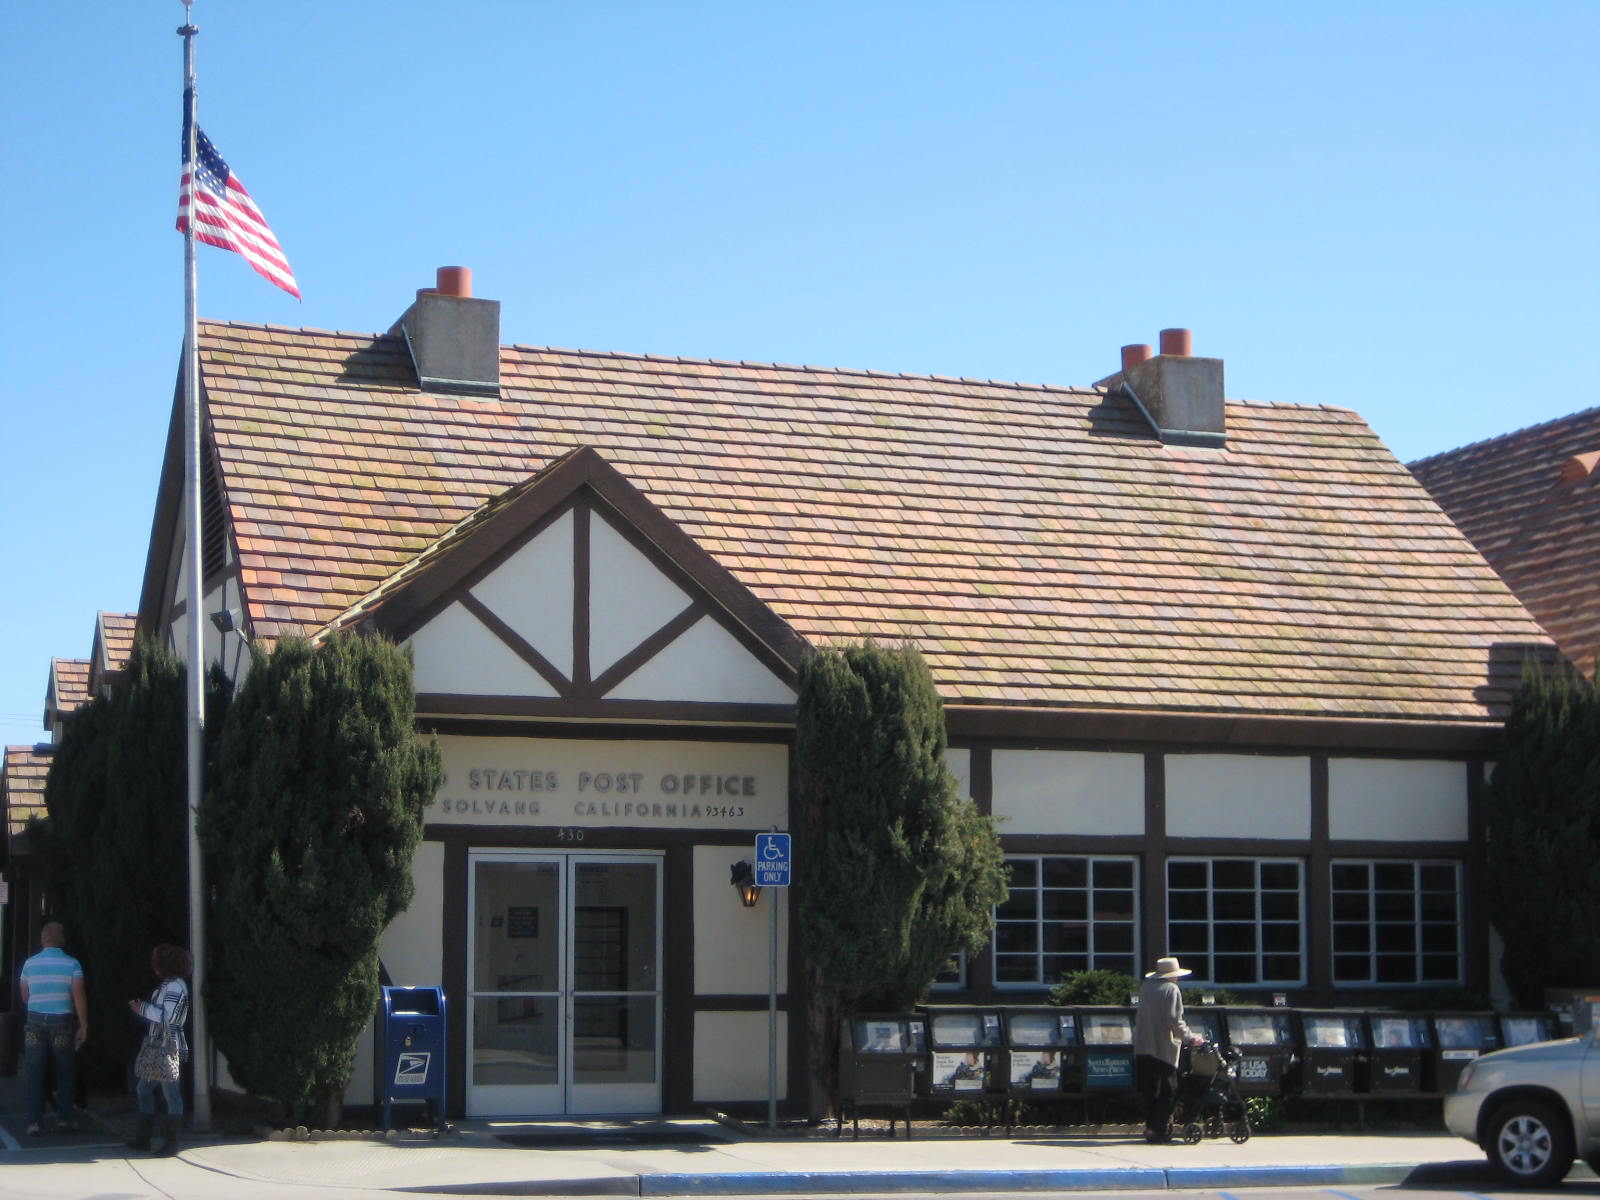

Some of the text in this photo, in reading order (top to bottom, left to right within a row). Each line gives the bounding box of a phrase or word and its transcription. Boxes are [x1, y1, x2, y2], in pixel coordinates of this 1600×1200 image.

[469, 768, 559, 792] STATES
[578, 771, 644, 796] POST
[660, 773, 757, 798] OFFICE
[442, 799, 745, 818] SOLVANG CALIFORNIA 93463
[757, 861, 789, 872] PARKING
[763, 871, 782, 882] ONLY
[1249, 1060, 1267, 1069] USA
[1240, 1069, 1268, 1079] TODAY
